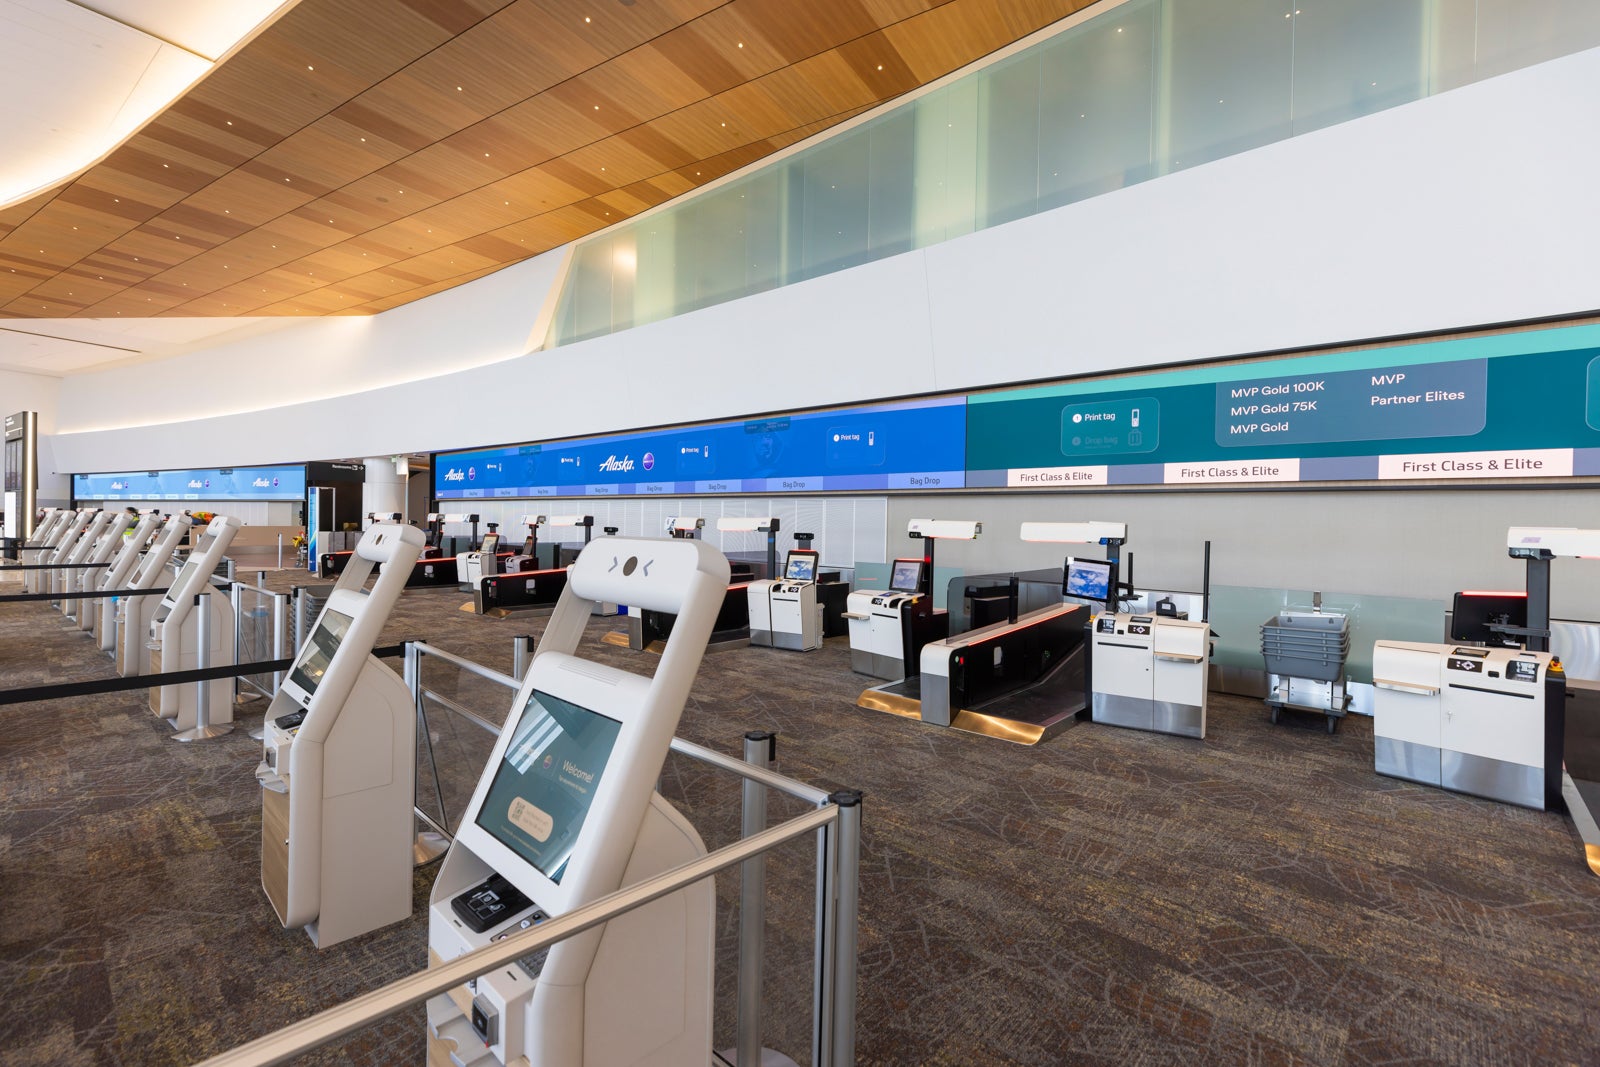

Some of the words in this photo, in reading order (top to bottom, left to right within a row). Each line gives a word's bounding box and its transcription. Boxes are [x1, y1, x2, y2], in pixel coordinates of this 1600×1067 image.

[1371, 373, 1405, 386] MVP
[1231, 387, 1259, 398] MVP
[1261, 384, 1290, 396] Gold
[1293, 380, 1325, 393] 100K
[1371, 395, 1421, 406] Partner
[1425, 390, 1465, 402] Elites
[1231, 405, 1259, 416] MVP
[1261, 403, 1289, 414] Gold
[1292, 400, 1317, 412] 75K
[1084, 413, 1102, 421] Print
[1103, 413, 1116, 421] tag
[1230, 423, 1258, 434] MVP
[1260, 421, 1289, 432] Gold
[599, 454, 634, 472] Alaska
[1402, 461, 1437, 473] First
[1441, 460, 1483, 472] Class
[1488, 459, 1499, 470] &
[1504, 458, 1543, 470] Elite
[1020, 473, 1039, 482] First
[1040, 472, 1063, 482] Class
[1064, 472, 1071, 481] &
[1072, 471, 1093, 481] Elite
[1181, 468, 1205, 478] First
[1208, 467, 1238, 477] Class
[1240, 467, 1249, 477] &
[1252, 466, 1280, 476] Elite
[708, 483, 717, 491] Bag
[717, 483, 727, 491] Drop
[782, 481, 793, 489] Bag
[793, 481, 806, 489] Drop
[910, 477, 923, 486] Bag
[924, 477, 941, 485] Drop
[562, 759, 595, 783] Welcome!
